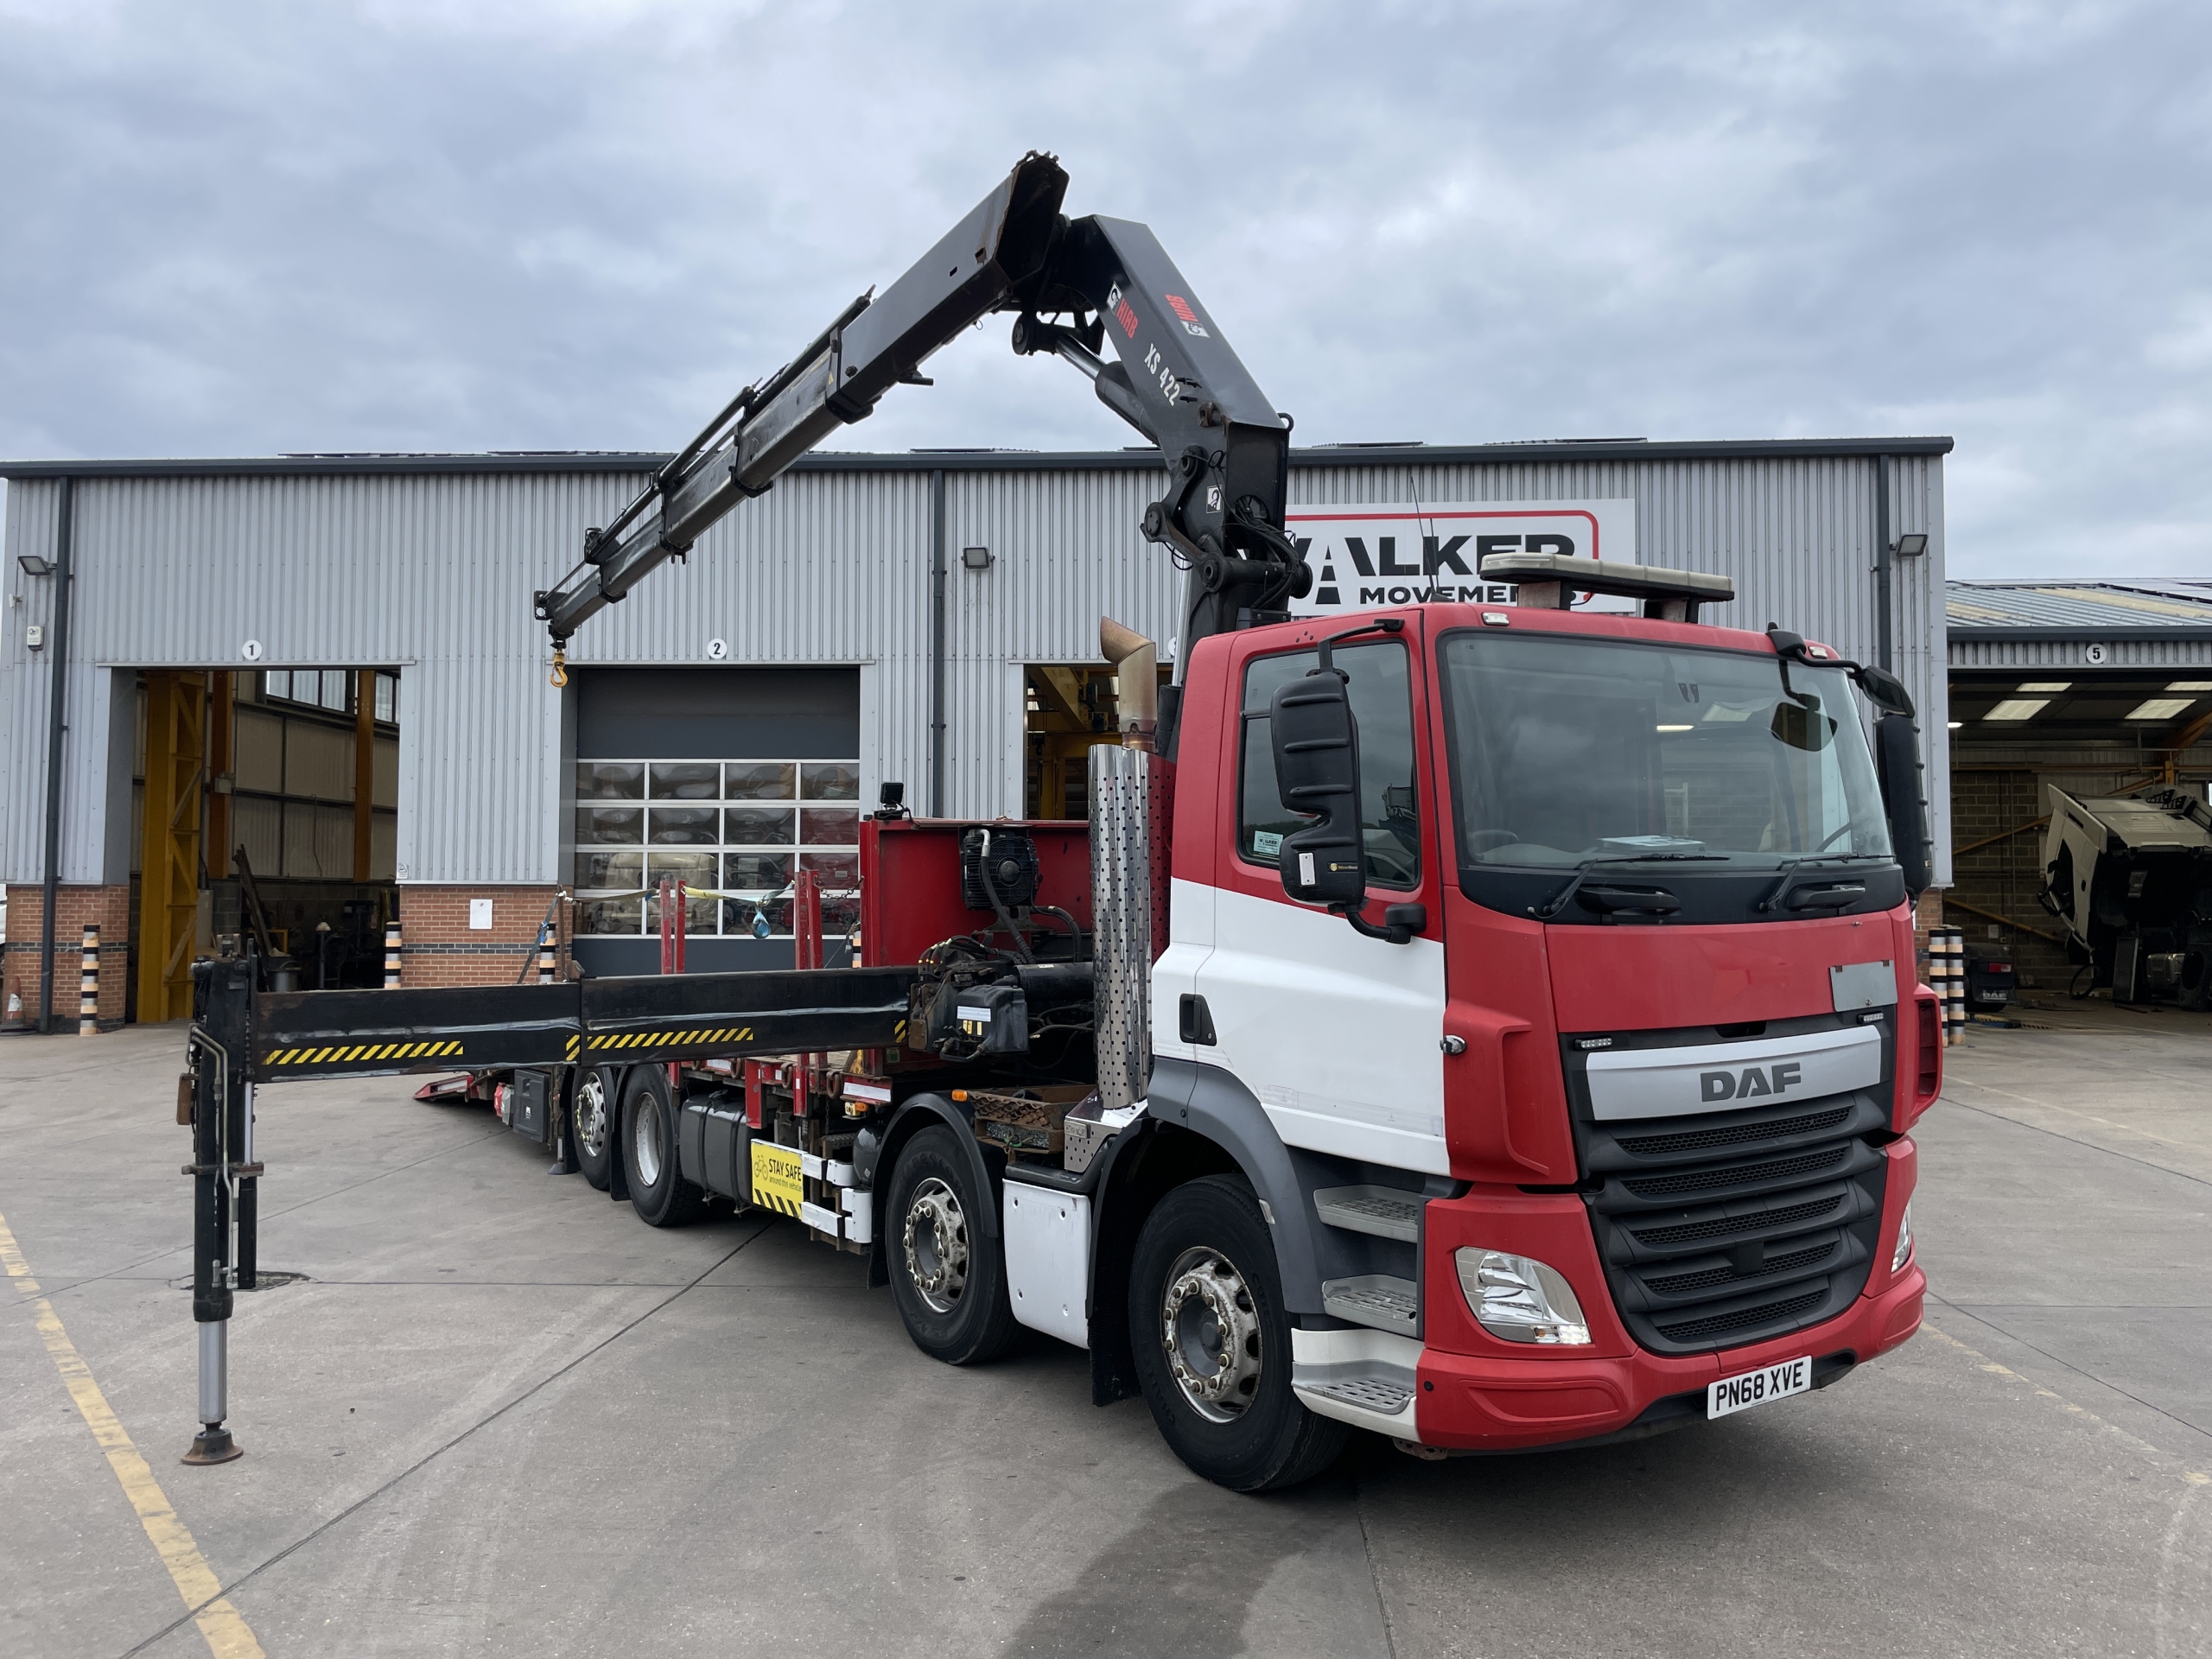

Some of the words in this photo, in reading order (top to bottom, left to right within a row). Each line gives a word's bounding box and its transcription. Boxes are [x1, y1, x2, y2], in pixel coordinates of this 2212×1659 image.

[1116, 297, 1139, 339] HIAB
[1165, 294, 1198, 322] HIAB
[1144, 342, 1161, 375] XS
[1159, 366, 1180, 406] 422
[1296, 534, 1575, 604] ALKE
[248, 644, 255, 656] 1
[714, 642, 721, 655] 2
[2092, 647, 2101, 660] 5
[1700, 1062, 1802, 1103] DAF
[769, 1158, 785, 1176] STAY
[785, 1162, 802, 1182] SAFE
[769, 1175, 782, 1185] around
[789, 1181, 802, 1192] vehicle
[1716, 1373, 1764, 1411] PN68
[1770, 1361, 1803, 1395] XVE
